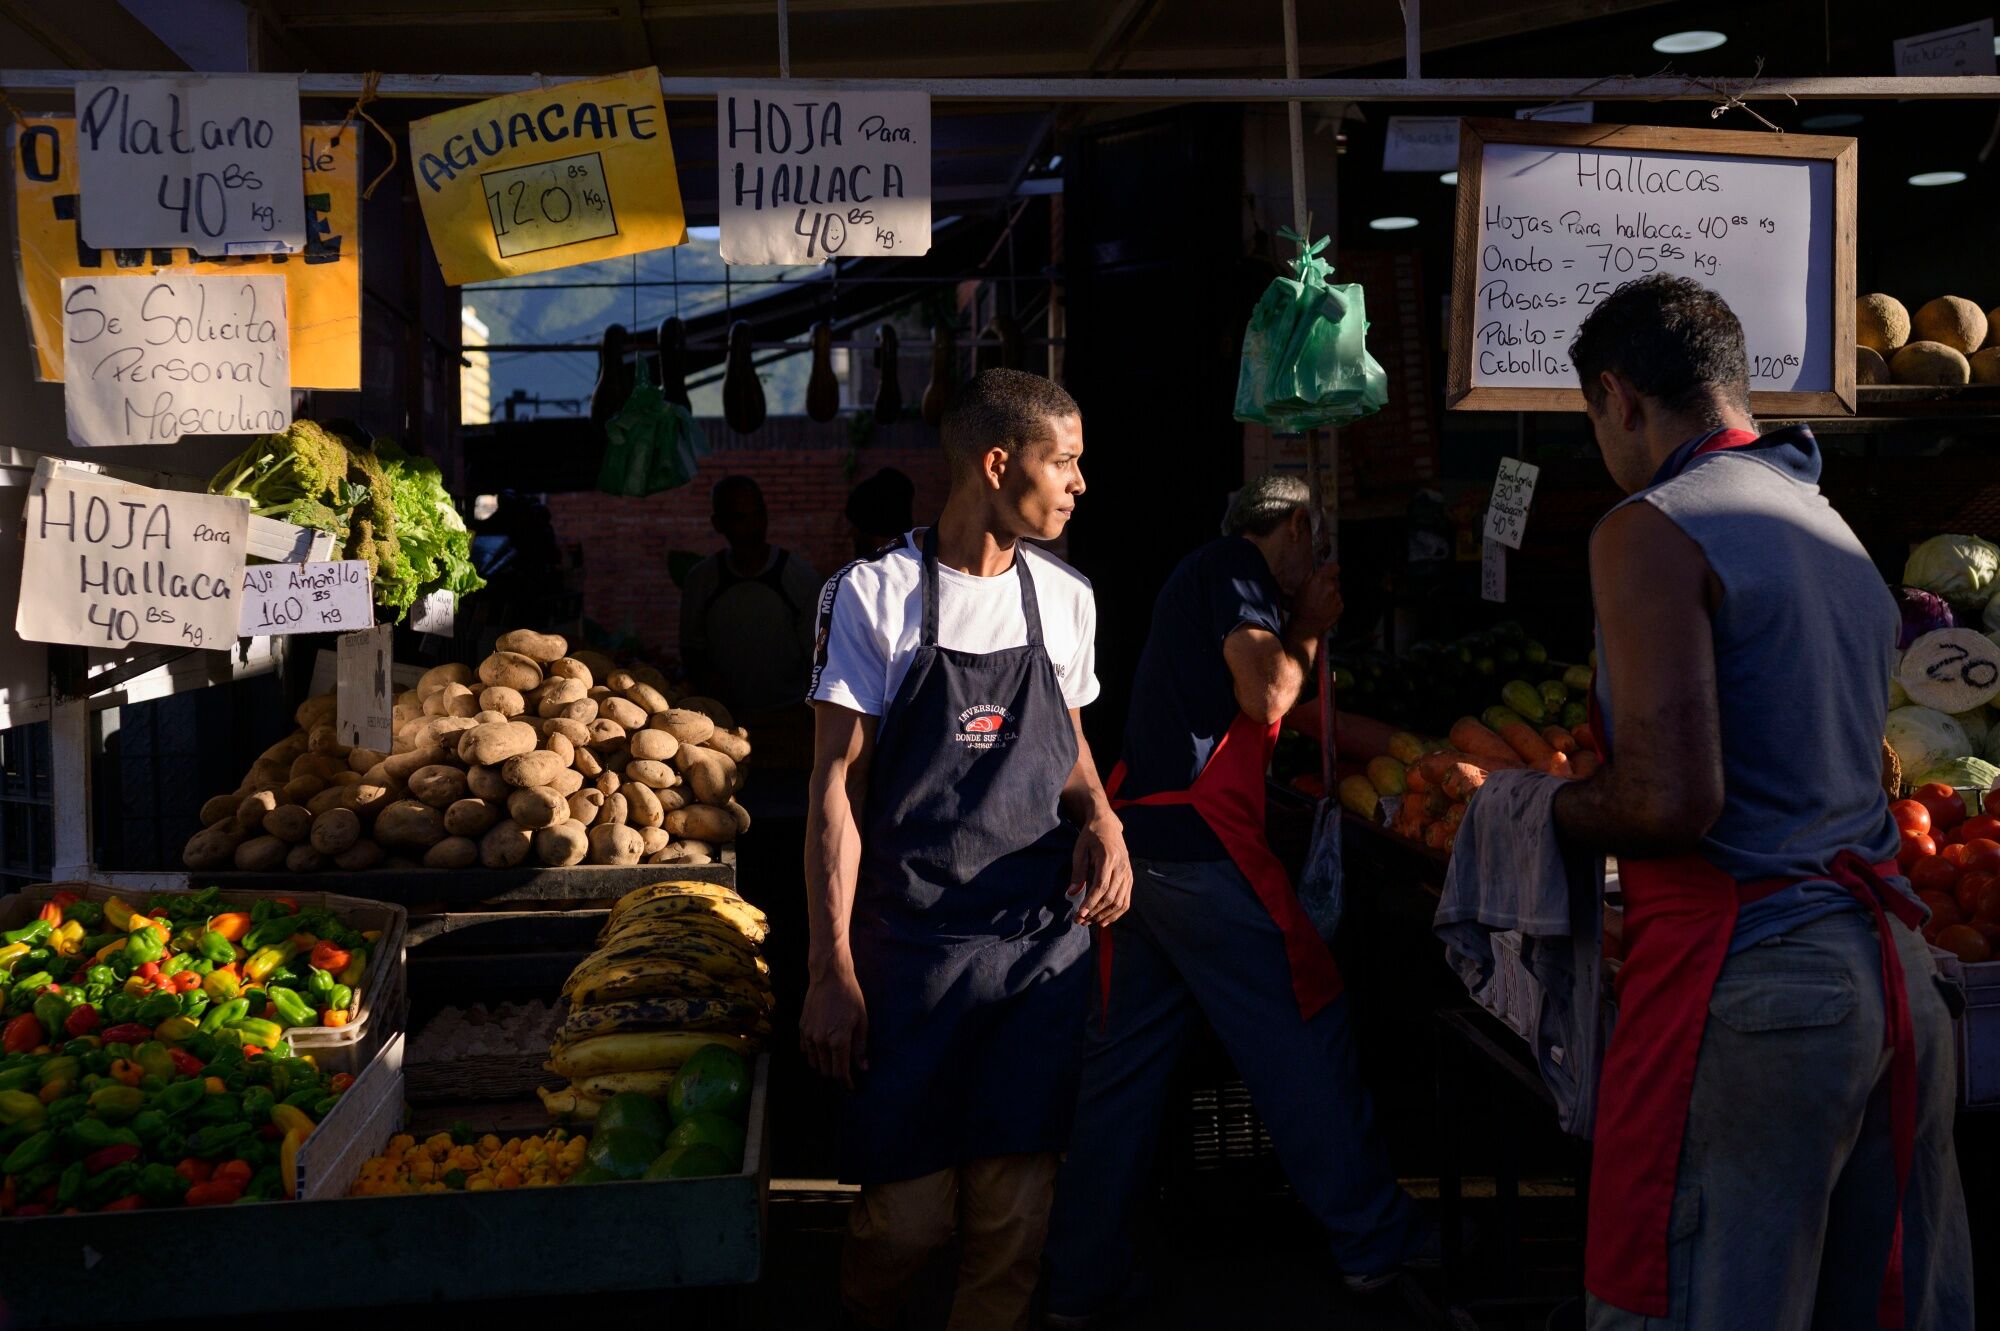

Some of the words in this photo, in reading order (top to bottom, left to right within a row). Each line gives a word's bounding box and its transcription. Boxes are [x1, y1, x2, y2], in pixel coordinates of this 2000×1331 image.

[80, 86, 275, 155] Platano
[727, 96, 842, 155] HOJA
[417, 102, 658, 193] AGUACATE
[732, 162, 904, 210] HALLACA
[1576, 152, 1723, 194] Hallacas
[158, 172, 227, 237] 40
[485, 179, 573, 237] 120
[1559, 210, 1601, 237] Para
[1698, 215, 1728, 240] 40
[794, 209, 848, 259] 40
[1483, 245, 1553, 273] Onoto
[1586, 243, 1659, 273] 705
[64, 284, 123, 344] Se
[141, 283, 277, 346] Solicita
[1477, 320, 1546, 348] Pabilo
[92, 347, 272, 388] Personal
[124, 391, 286, 441] Masculino
[38, 488, 172, 551] HOJA
[79, 554, 231, 601] Hallaca
[87, 604, 140, 642] 40
[257, 596, 303, 627] 160
[1926, 643, 1999, 688] 20
[958, 704, 1016, 723] INVERSIONES
[956, 733, 981, 743] DONDE
